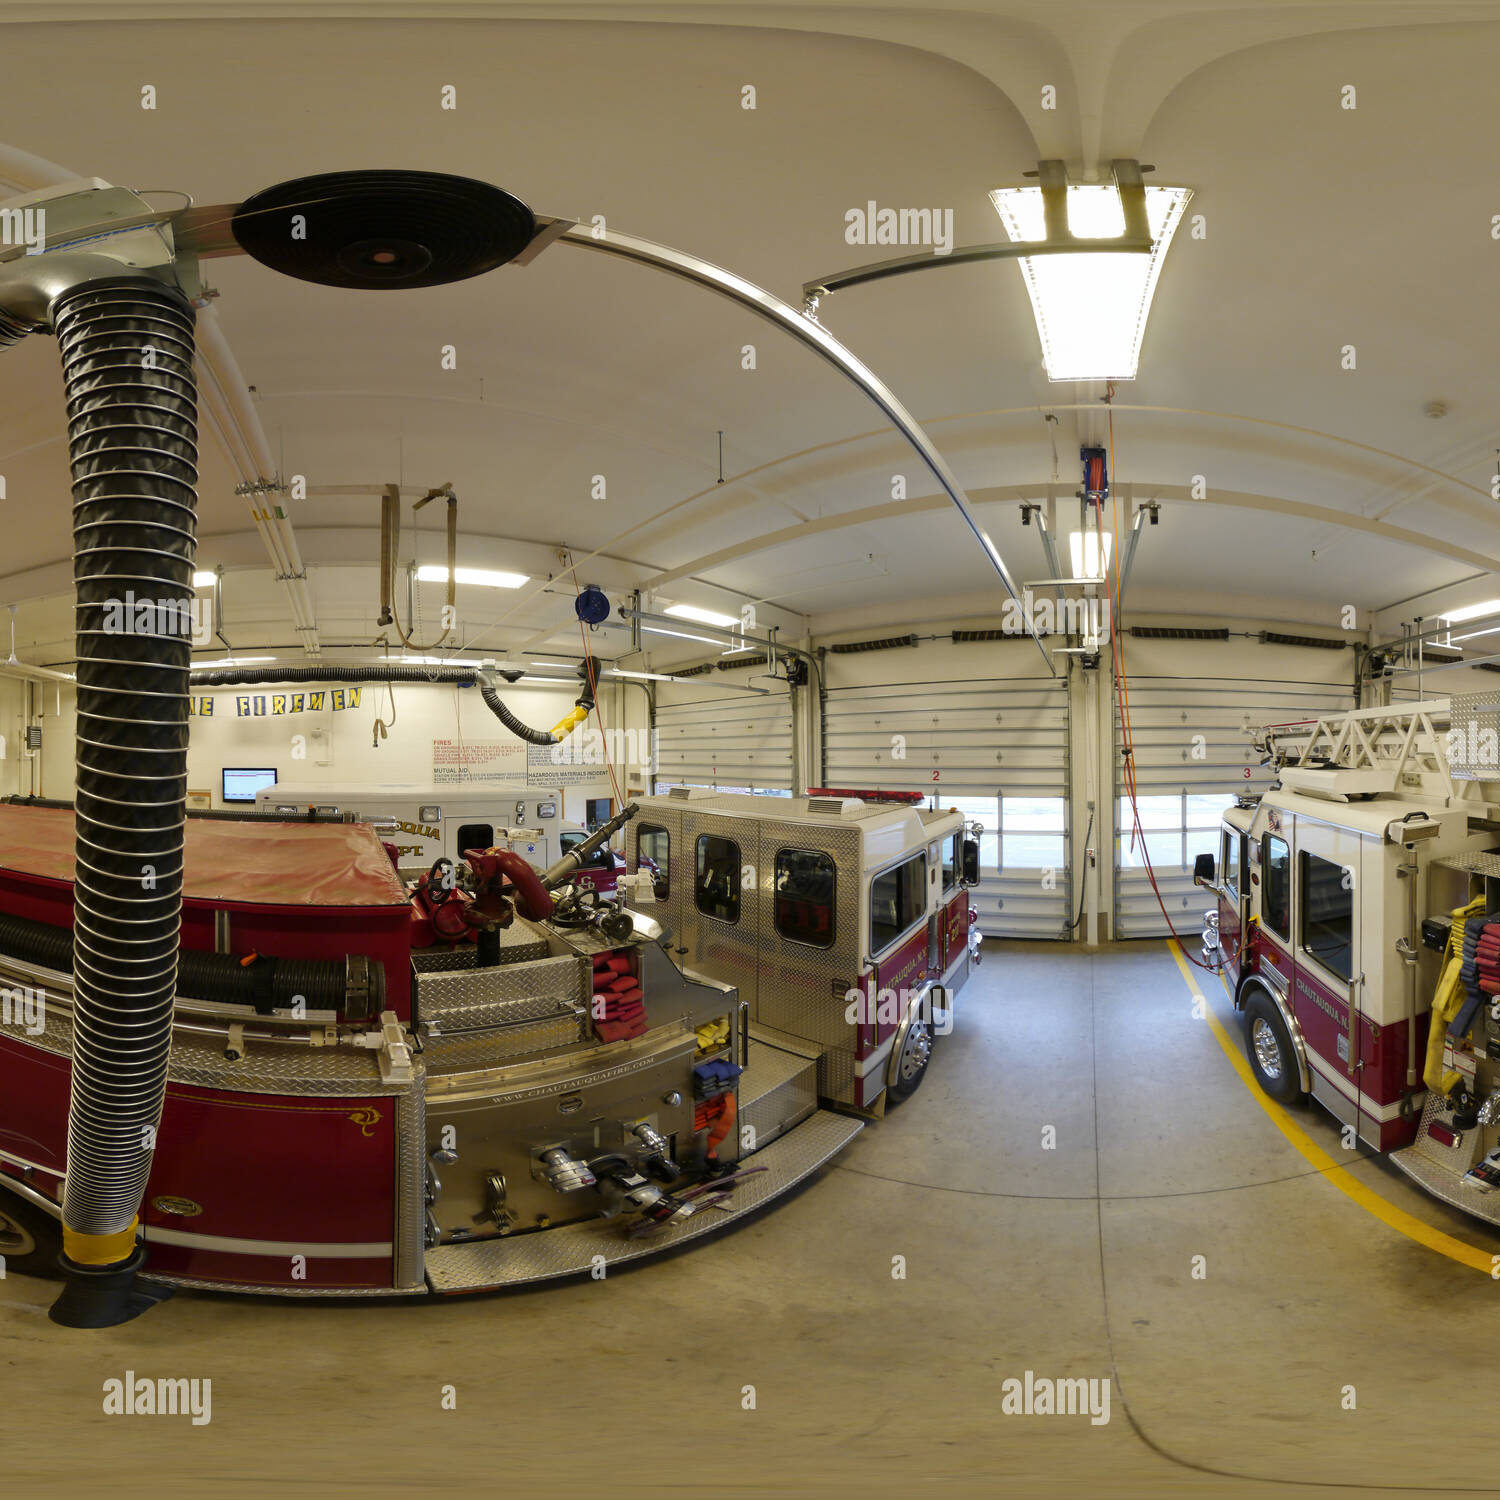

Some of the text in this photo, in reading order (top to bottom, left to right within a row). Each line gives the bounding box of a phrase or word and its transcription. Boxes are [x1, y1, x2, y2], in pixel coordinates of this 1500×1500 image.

[237, 687, 363, 717] FIREMEN
[932, 770, 941, 781] 2
[1243, 768, 1252, 780] 3
